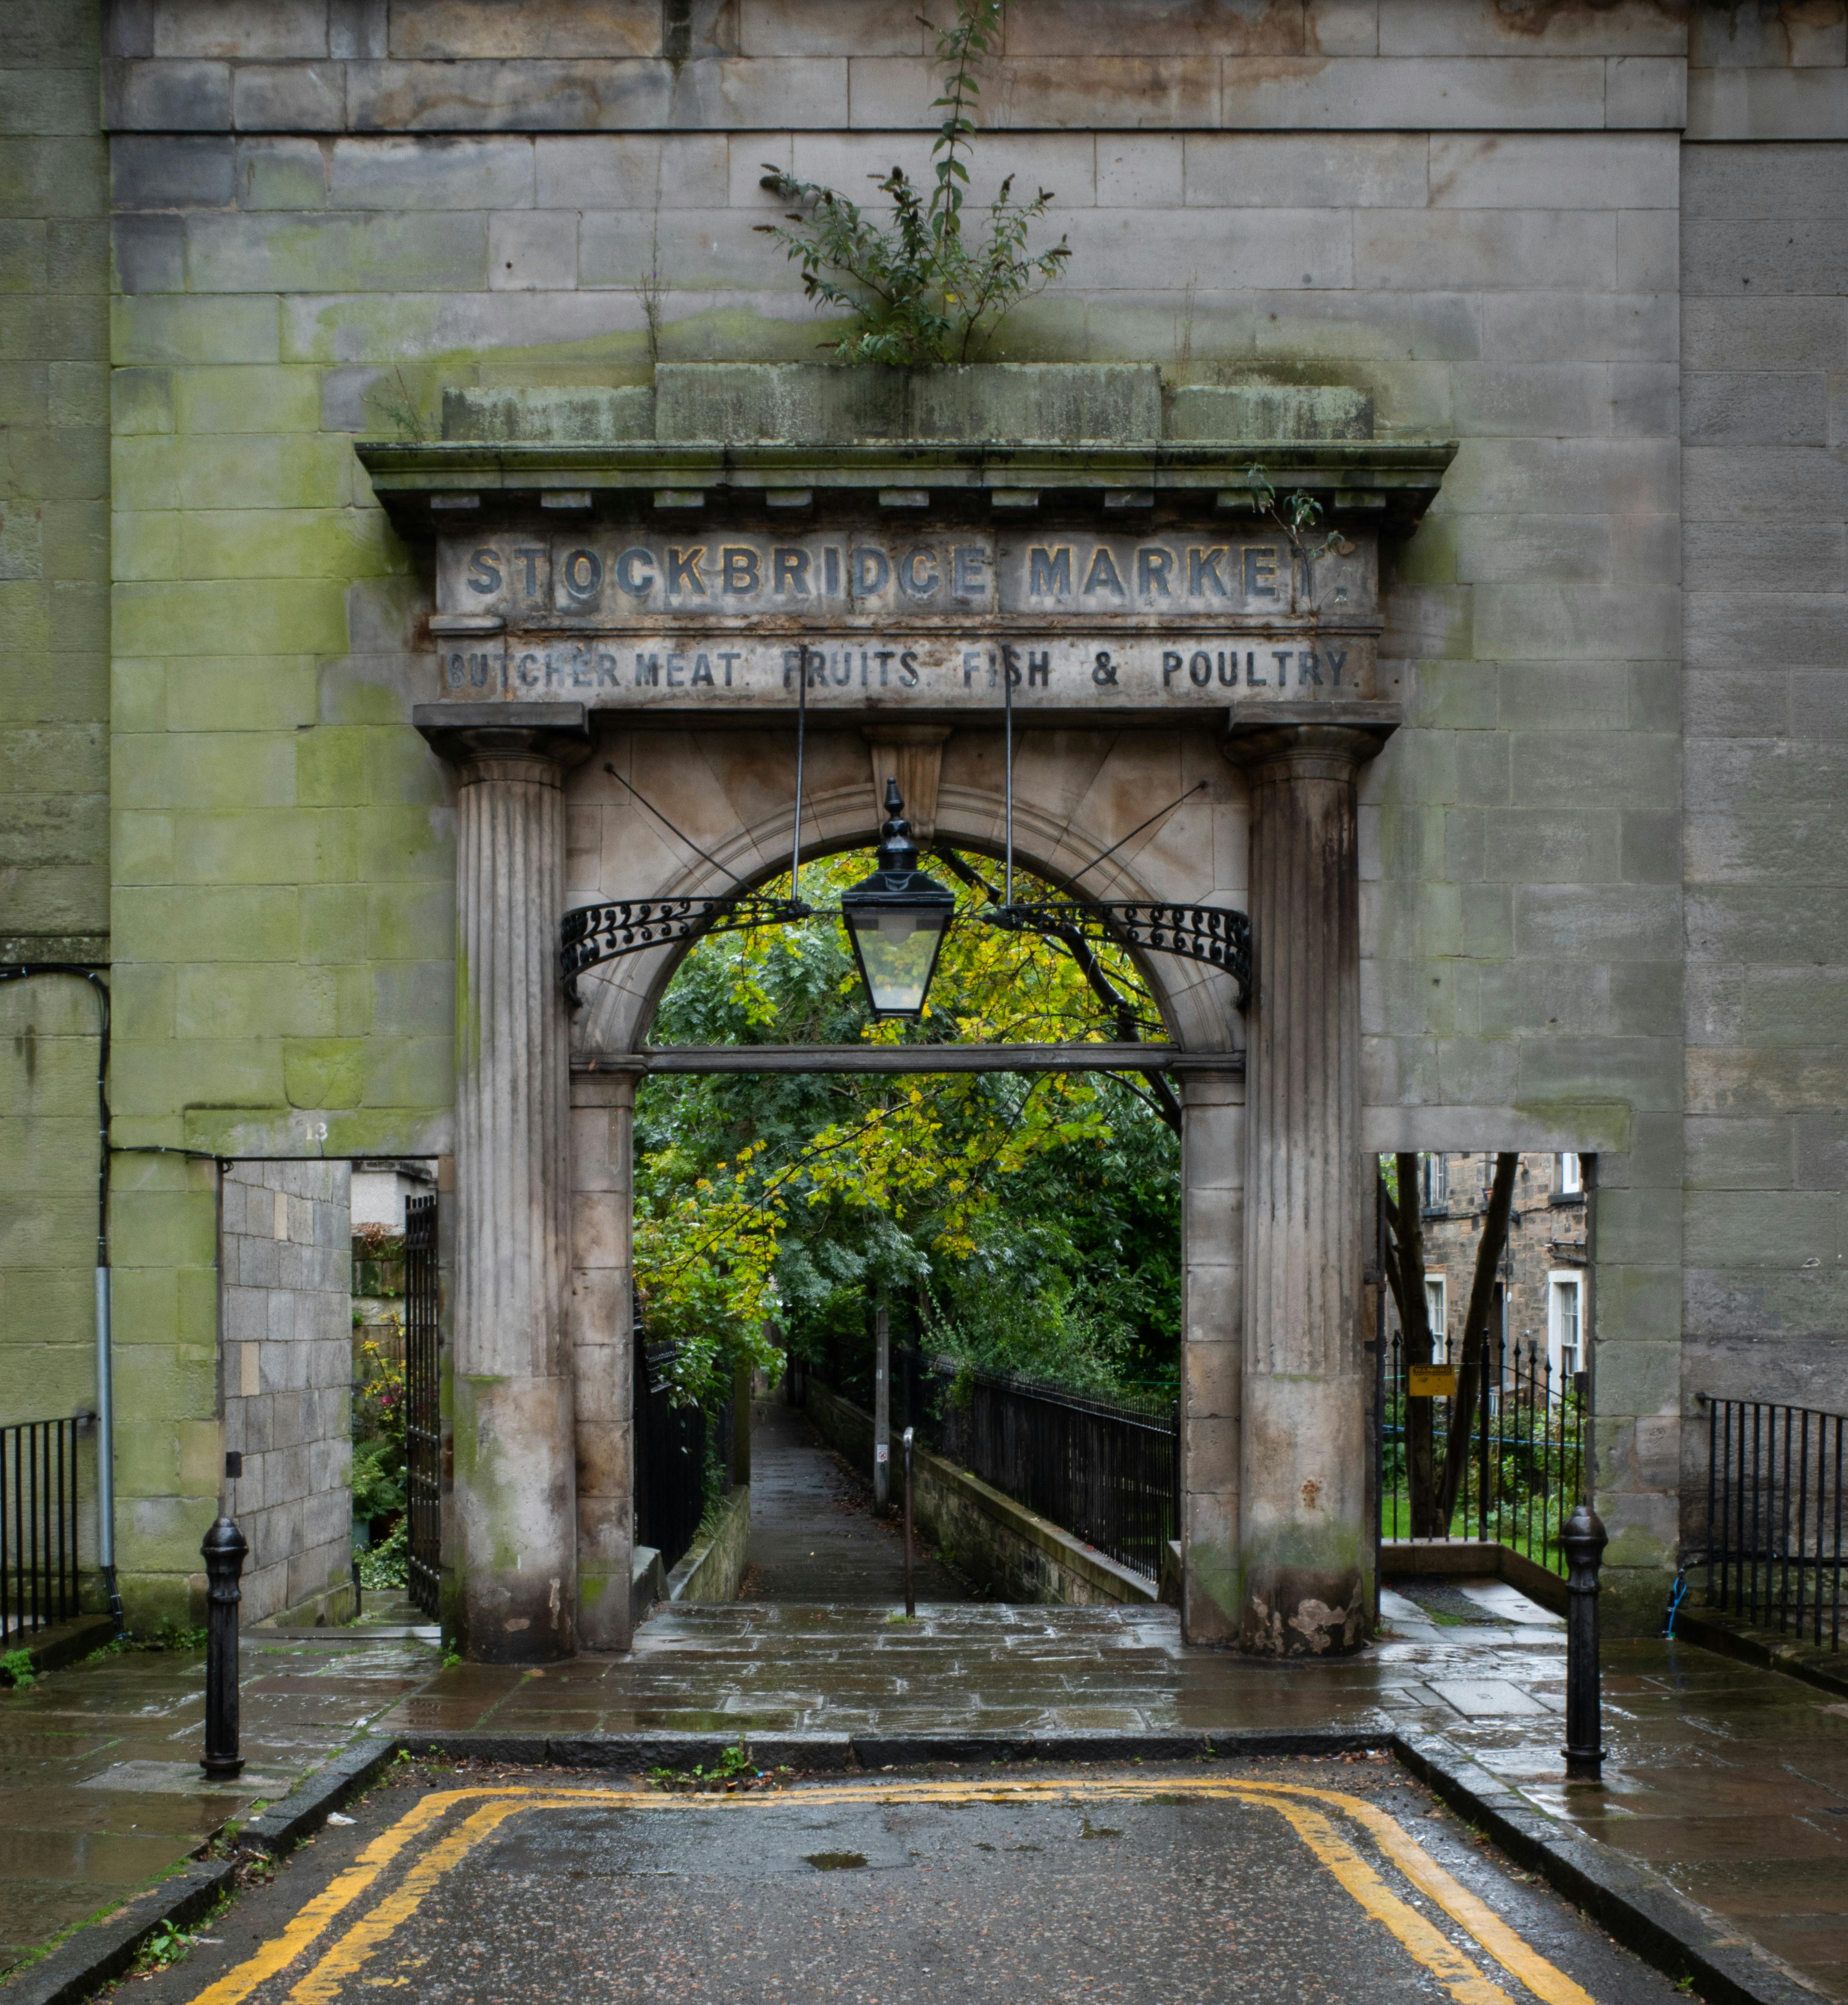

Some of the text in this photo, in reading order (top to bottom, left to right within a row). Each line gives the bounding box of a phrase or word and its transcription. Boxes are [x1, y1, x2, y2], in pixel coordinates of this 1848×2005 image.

[467, 545, 986, 598] STOCKBRIDGE
[447, 653, 621, 689] BUTCHER
[963, 650, 1049, 687] FISH
[1092, 651, 1119, 685] &
[306, 1122, 328, 1140] 13
